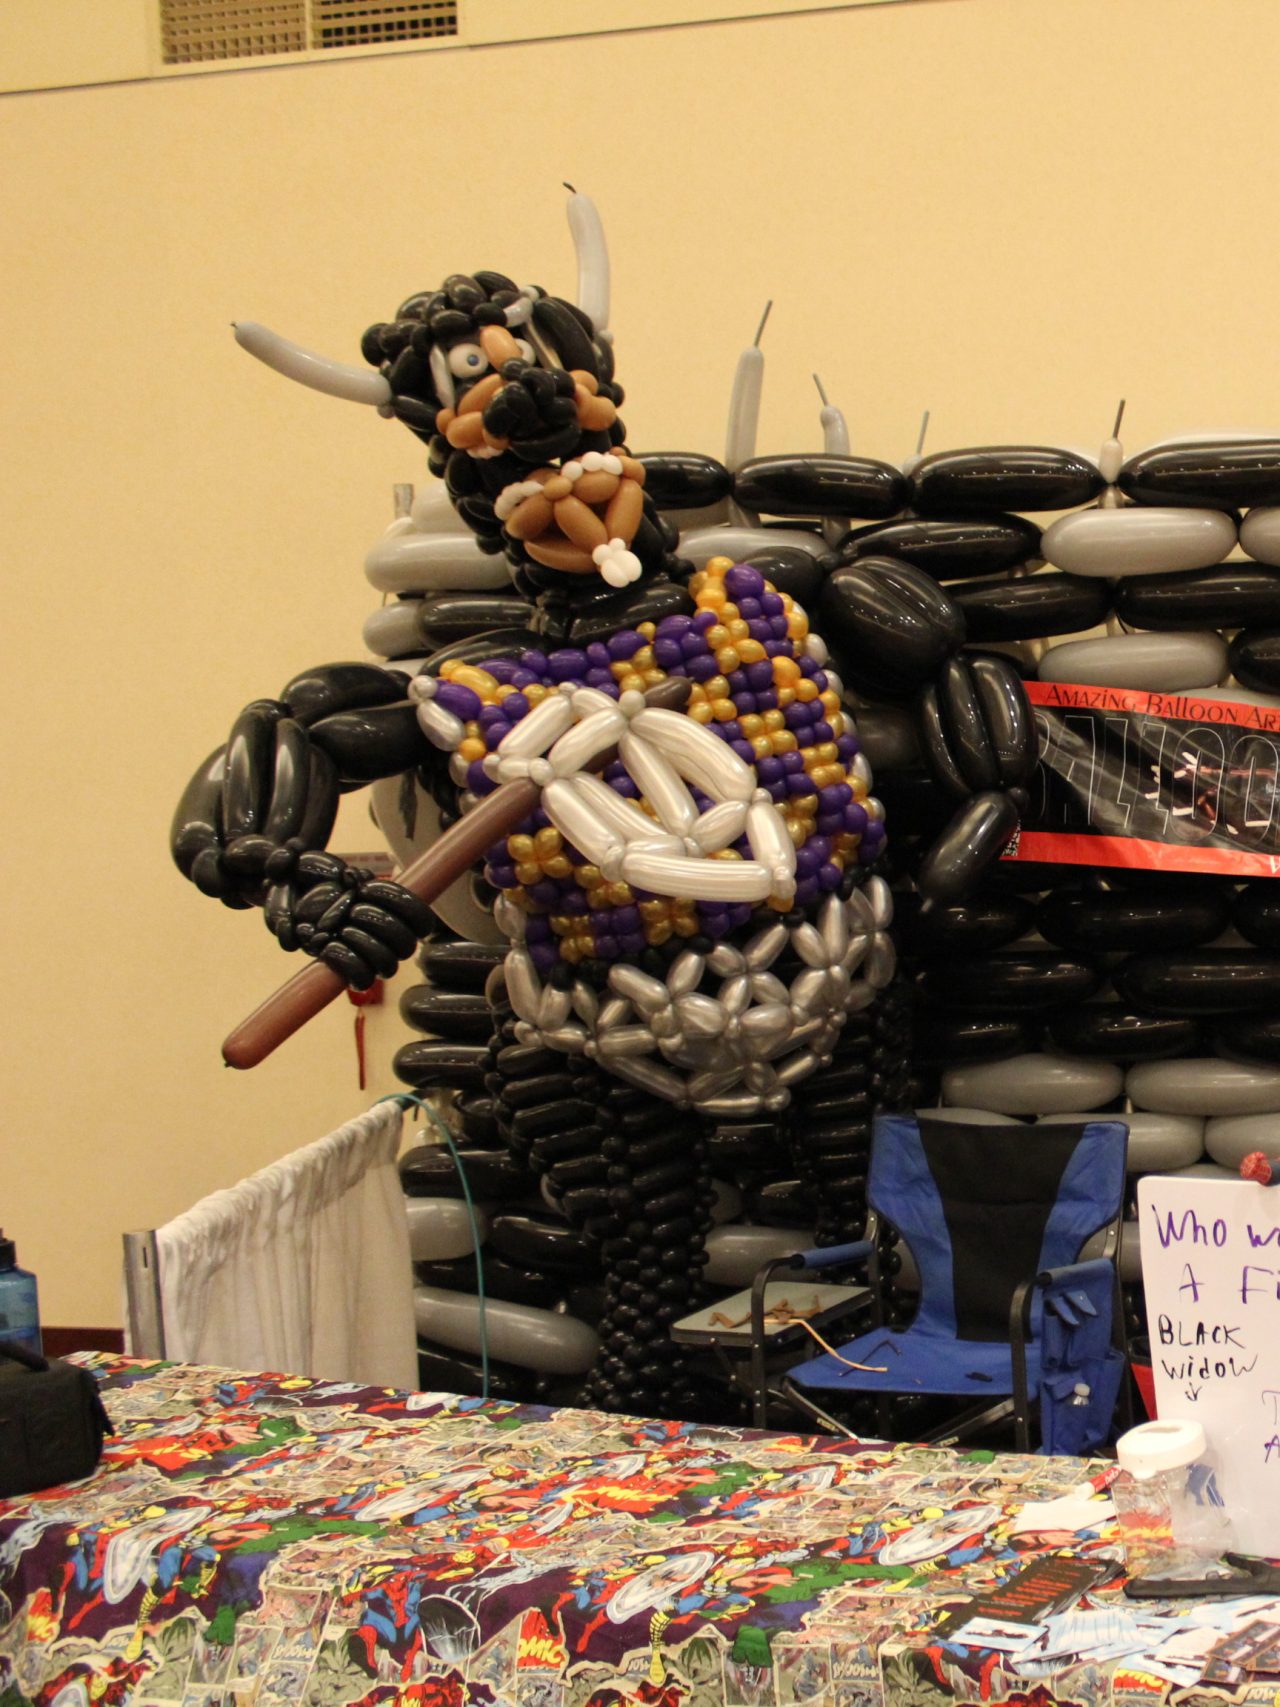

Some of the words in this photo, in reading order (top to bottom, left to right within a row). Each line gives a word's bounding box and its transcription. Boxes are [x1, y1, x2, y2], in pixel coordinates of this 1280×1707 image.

[1151, 1204, 1228, 1248] Who
[1178, 1263, 1205, 1303] A
[1158, 1314, 1246, 1349] BLACK
